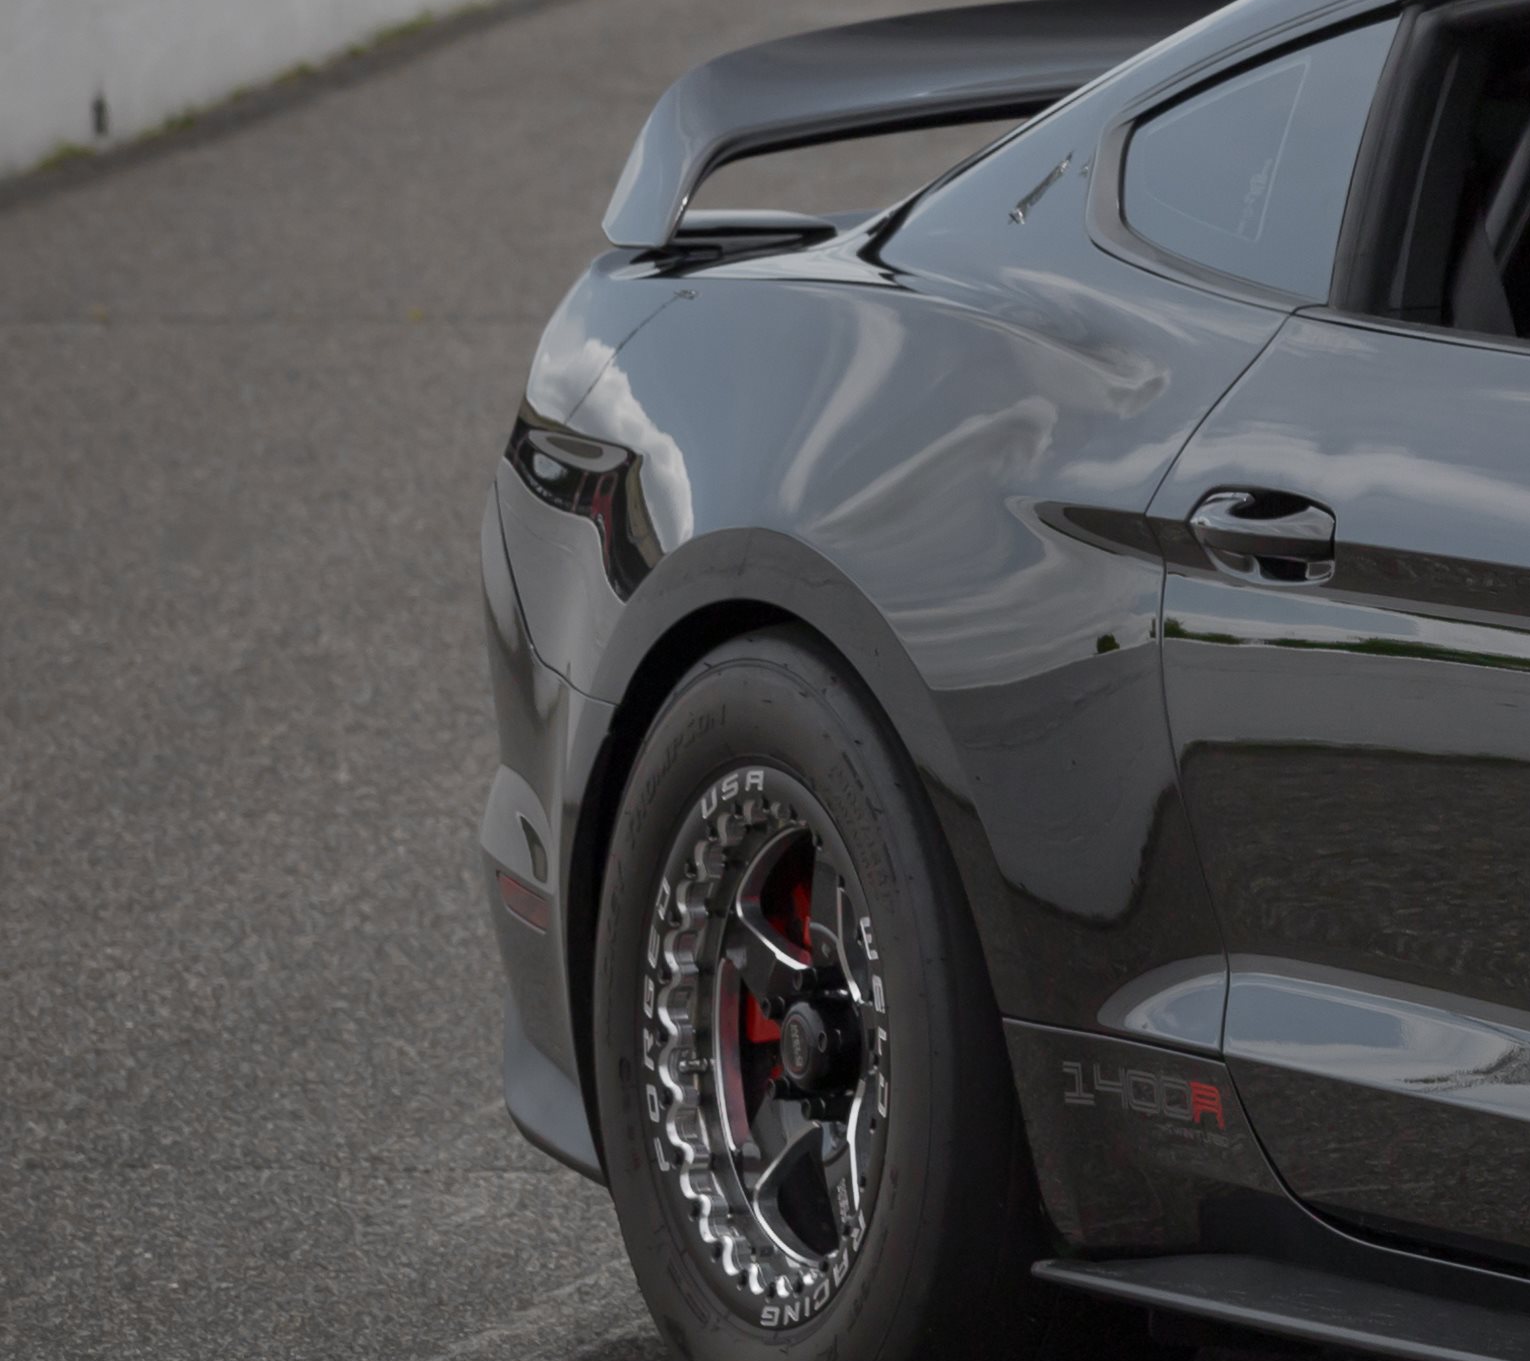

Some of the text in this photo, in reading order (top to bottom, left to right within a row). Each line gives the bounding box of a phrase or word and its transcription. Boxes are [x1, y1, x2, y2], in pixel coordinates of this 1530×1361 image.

[699, 768, 766, 820] USA
[640, 875, 672, 1173] FORGED
[859, 916, 891, 1121] WELD
[759, 1208, 867, 1329] RACING
